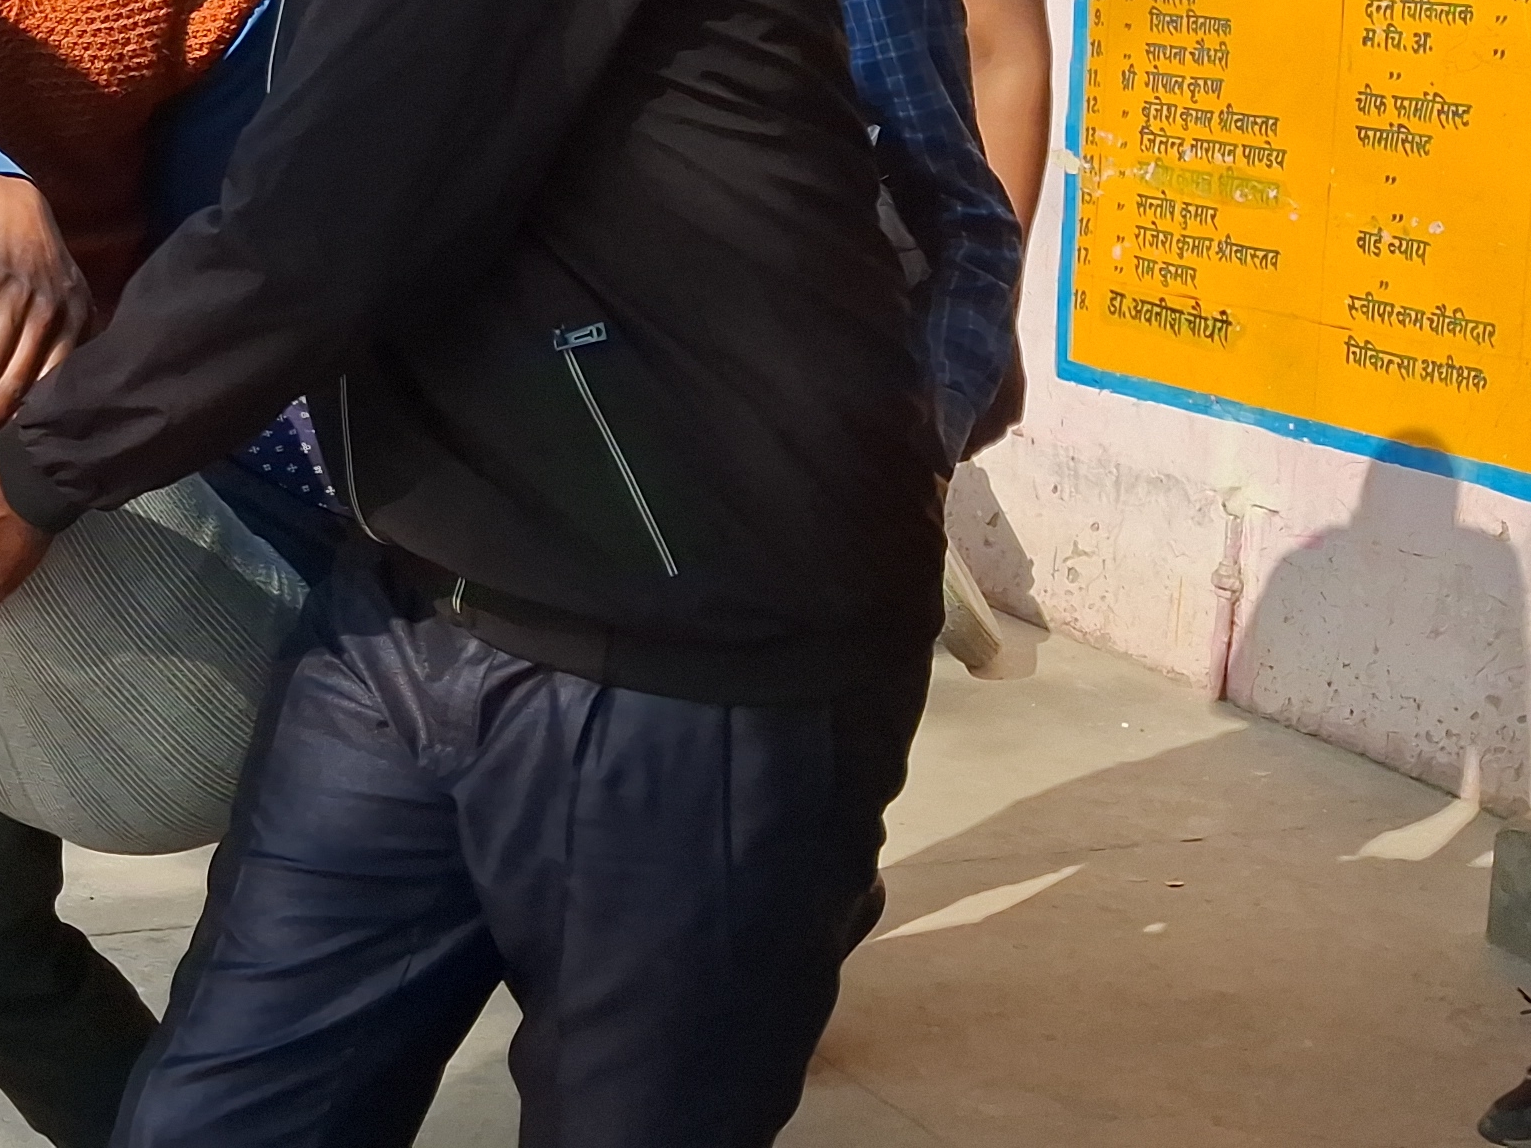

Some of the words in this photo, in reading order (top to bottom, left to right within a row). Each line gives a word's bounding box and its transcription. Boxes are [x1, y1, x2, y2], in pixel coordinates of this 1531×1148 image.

[1189, 37, 1231, 72] चौधरी
[1144, 64, 1186, 97] गोपाल
[1187, 76, 1225, 104] कृष्ण
[1179, 106, 1215, 135] कुमार
[1217, 103, 1280, 138] श्रीवास्तव
[1179, 200, 1219, 232] कुमार
[1134, 220, 1175, 255] राजेश
[1176, 234, 1215, 261] कुमार
[1216, 232, 1282, 272] श्रीवास्तव
[1133, 254, 1159, 282] राम
[1159, 260, 1198, 290] कुमार
[1426, 303, 1497, 349] चौकीदार
